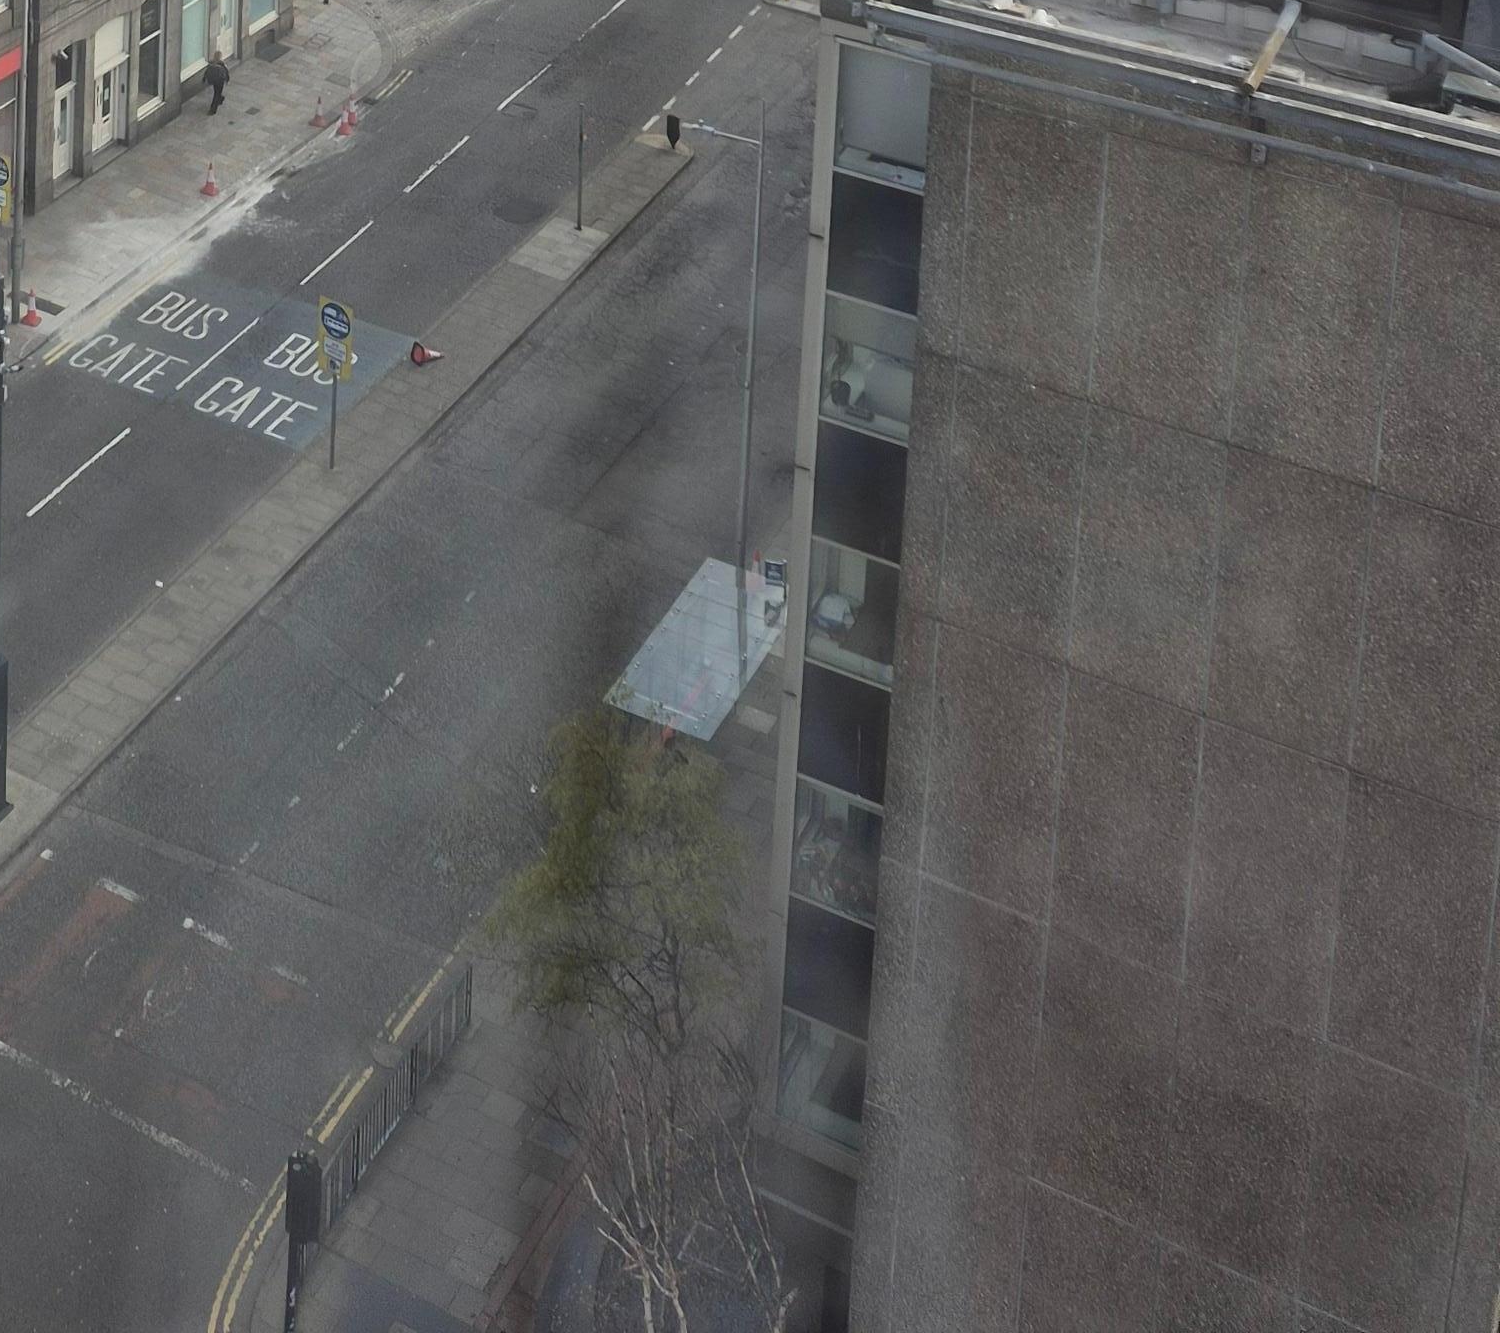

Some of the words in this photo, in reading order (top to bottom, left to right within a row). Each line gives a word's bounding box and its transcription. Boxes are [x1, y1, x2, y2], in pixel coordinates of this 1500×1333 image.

[137, 290, 229, 340] BUS
[68, 333, 189, 394] GATE
[193, 376, 318, 440] GATE
